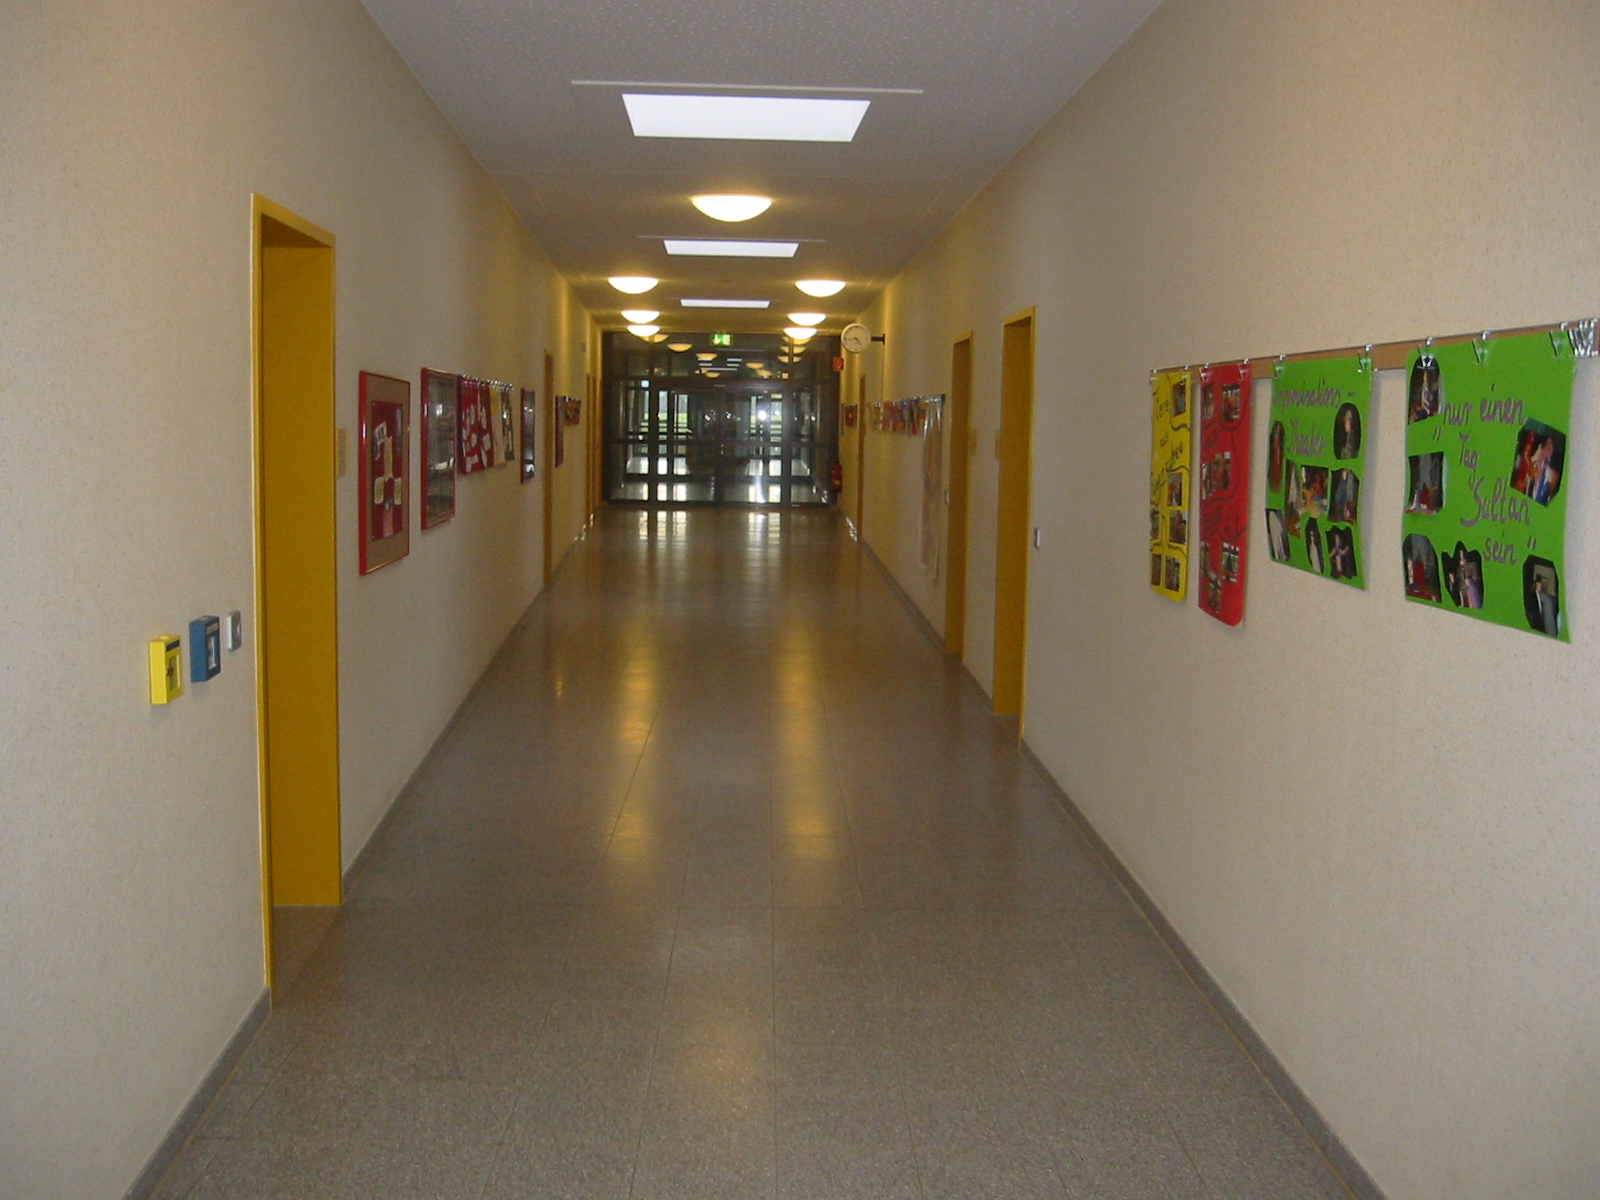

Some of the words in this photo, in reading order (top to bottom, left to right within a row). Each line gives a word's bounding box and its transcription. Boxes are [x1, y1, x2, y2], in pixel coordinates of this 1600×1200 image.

[1479, 383, 1526, 425] einen
[1459, 432, 1479, 490] Tag
[1460, 476, 1532, 527] Sultan
